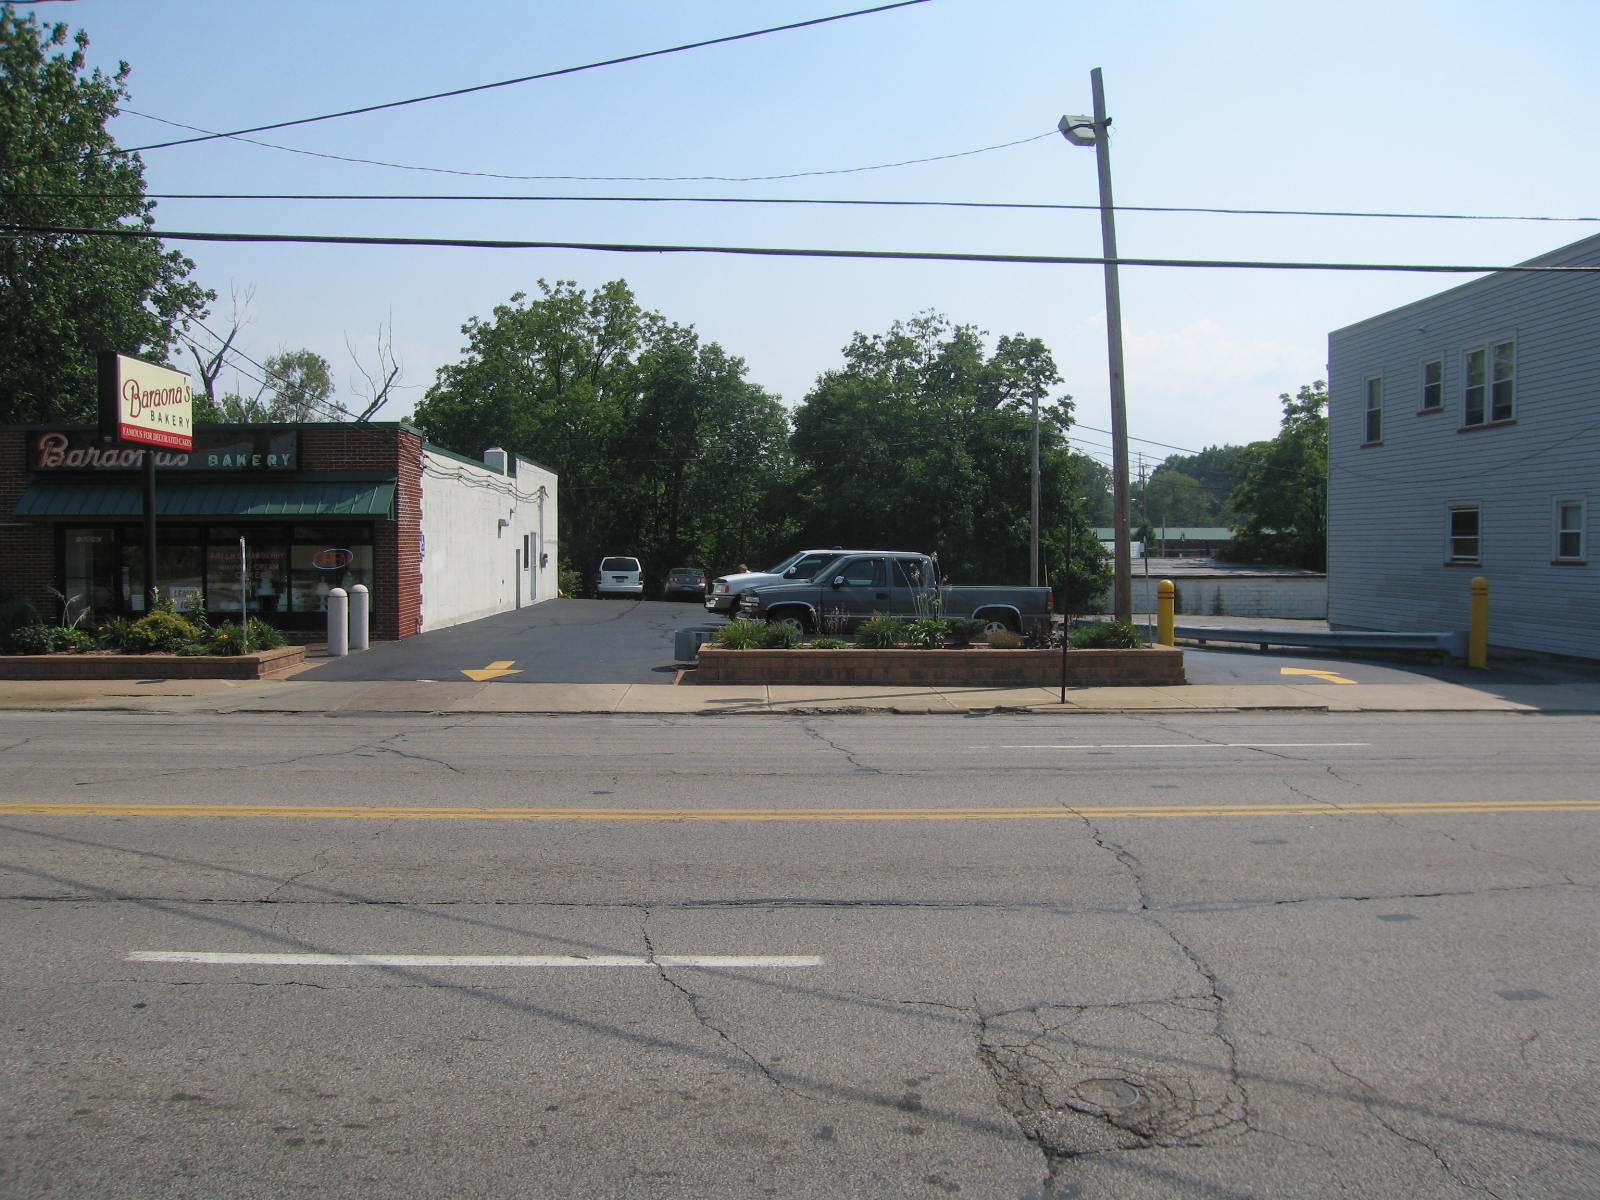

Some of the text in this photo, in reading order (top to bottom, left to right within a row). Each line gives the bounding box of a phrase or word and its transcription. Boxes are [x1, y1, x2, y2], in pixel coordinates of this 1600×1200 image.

[123, 377, 191, 418] Baraona's
[150, 410, 190, 429] BAKERY
[122, 427, 192, 447] FAMOUS FOR DECORATED CAKES
[208, 453, 291, 467] BAKERY
